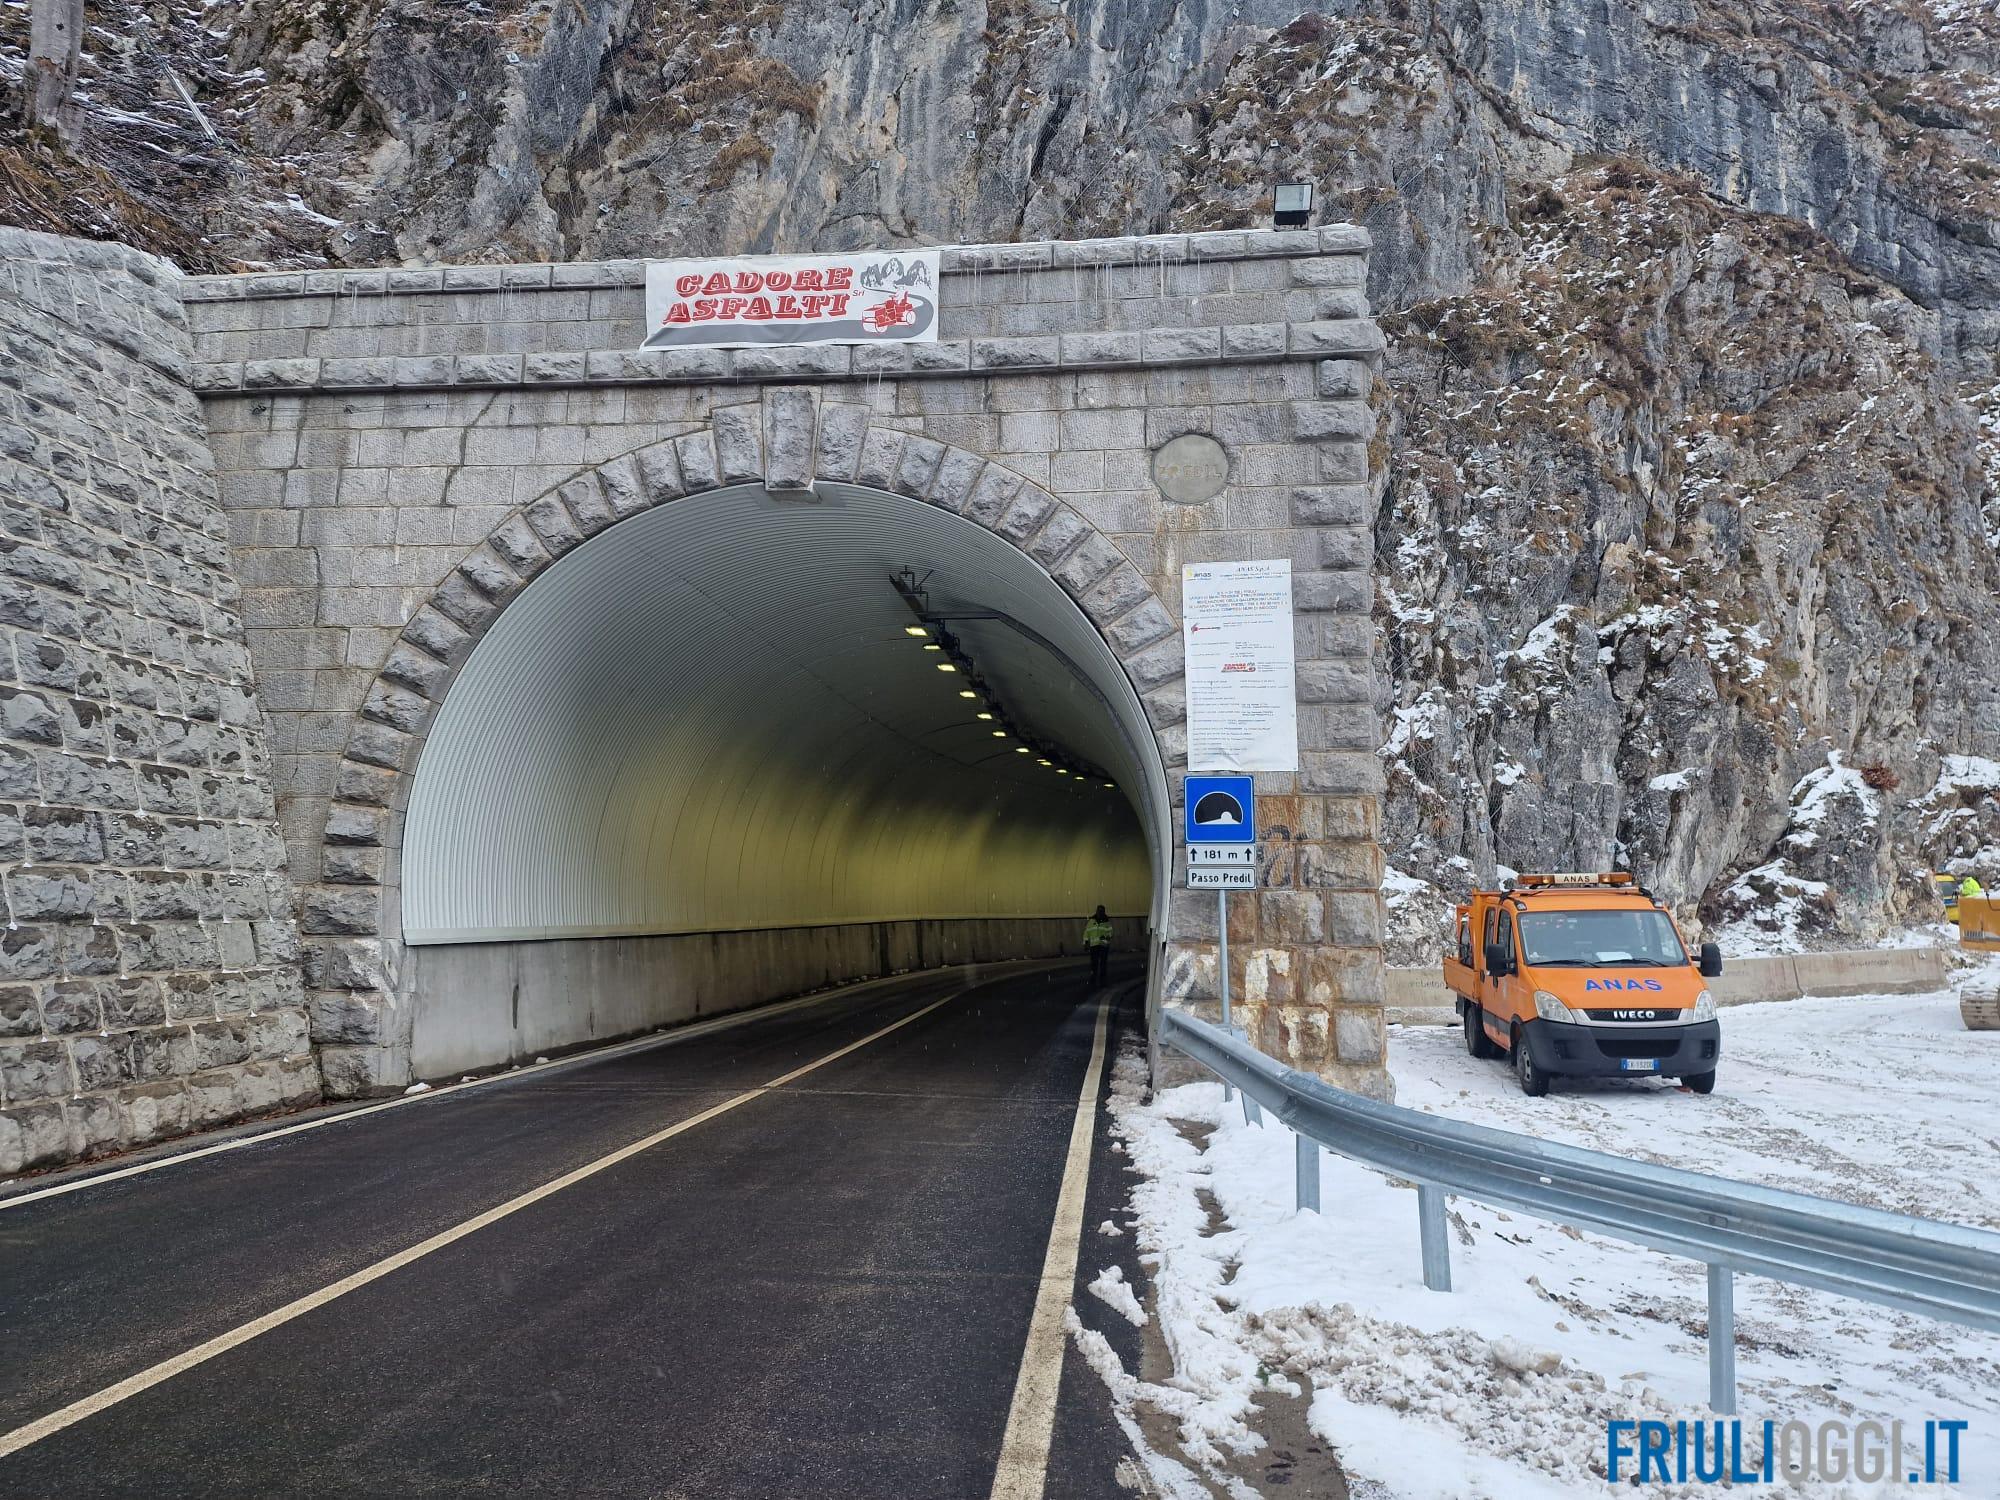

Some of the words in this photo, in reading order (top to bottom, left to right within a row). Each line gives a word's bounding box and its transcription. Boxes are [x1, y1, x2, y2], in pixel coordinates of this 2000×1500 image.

[675, 267, 853, 297] CADORE
[663, 294, 850, 325] ASFALTI
[1204, 850, 1221, 859] 181
[1228, 851, 1238, 859] m
[1191, 872, 1219, 883] Passo
[1223, 873, 1251, 883] Predil
[1564, 875, 1590, 883] ANAS
[1586, 979, 1663, 991] ANAS
[1614, 1010, 1655, 1019] IVECO
